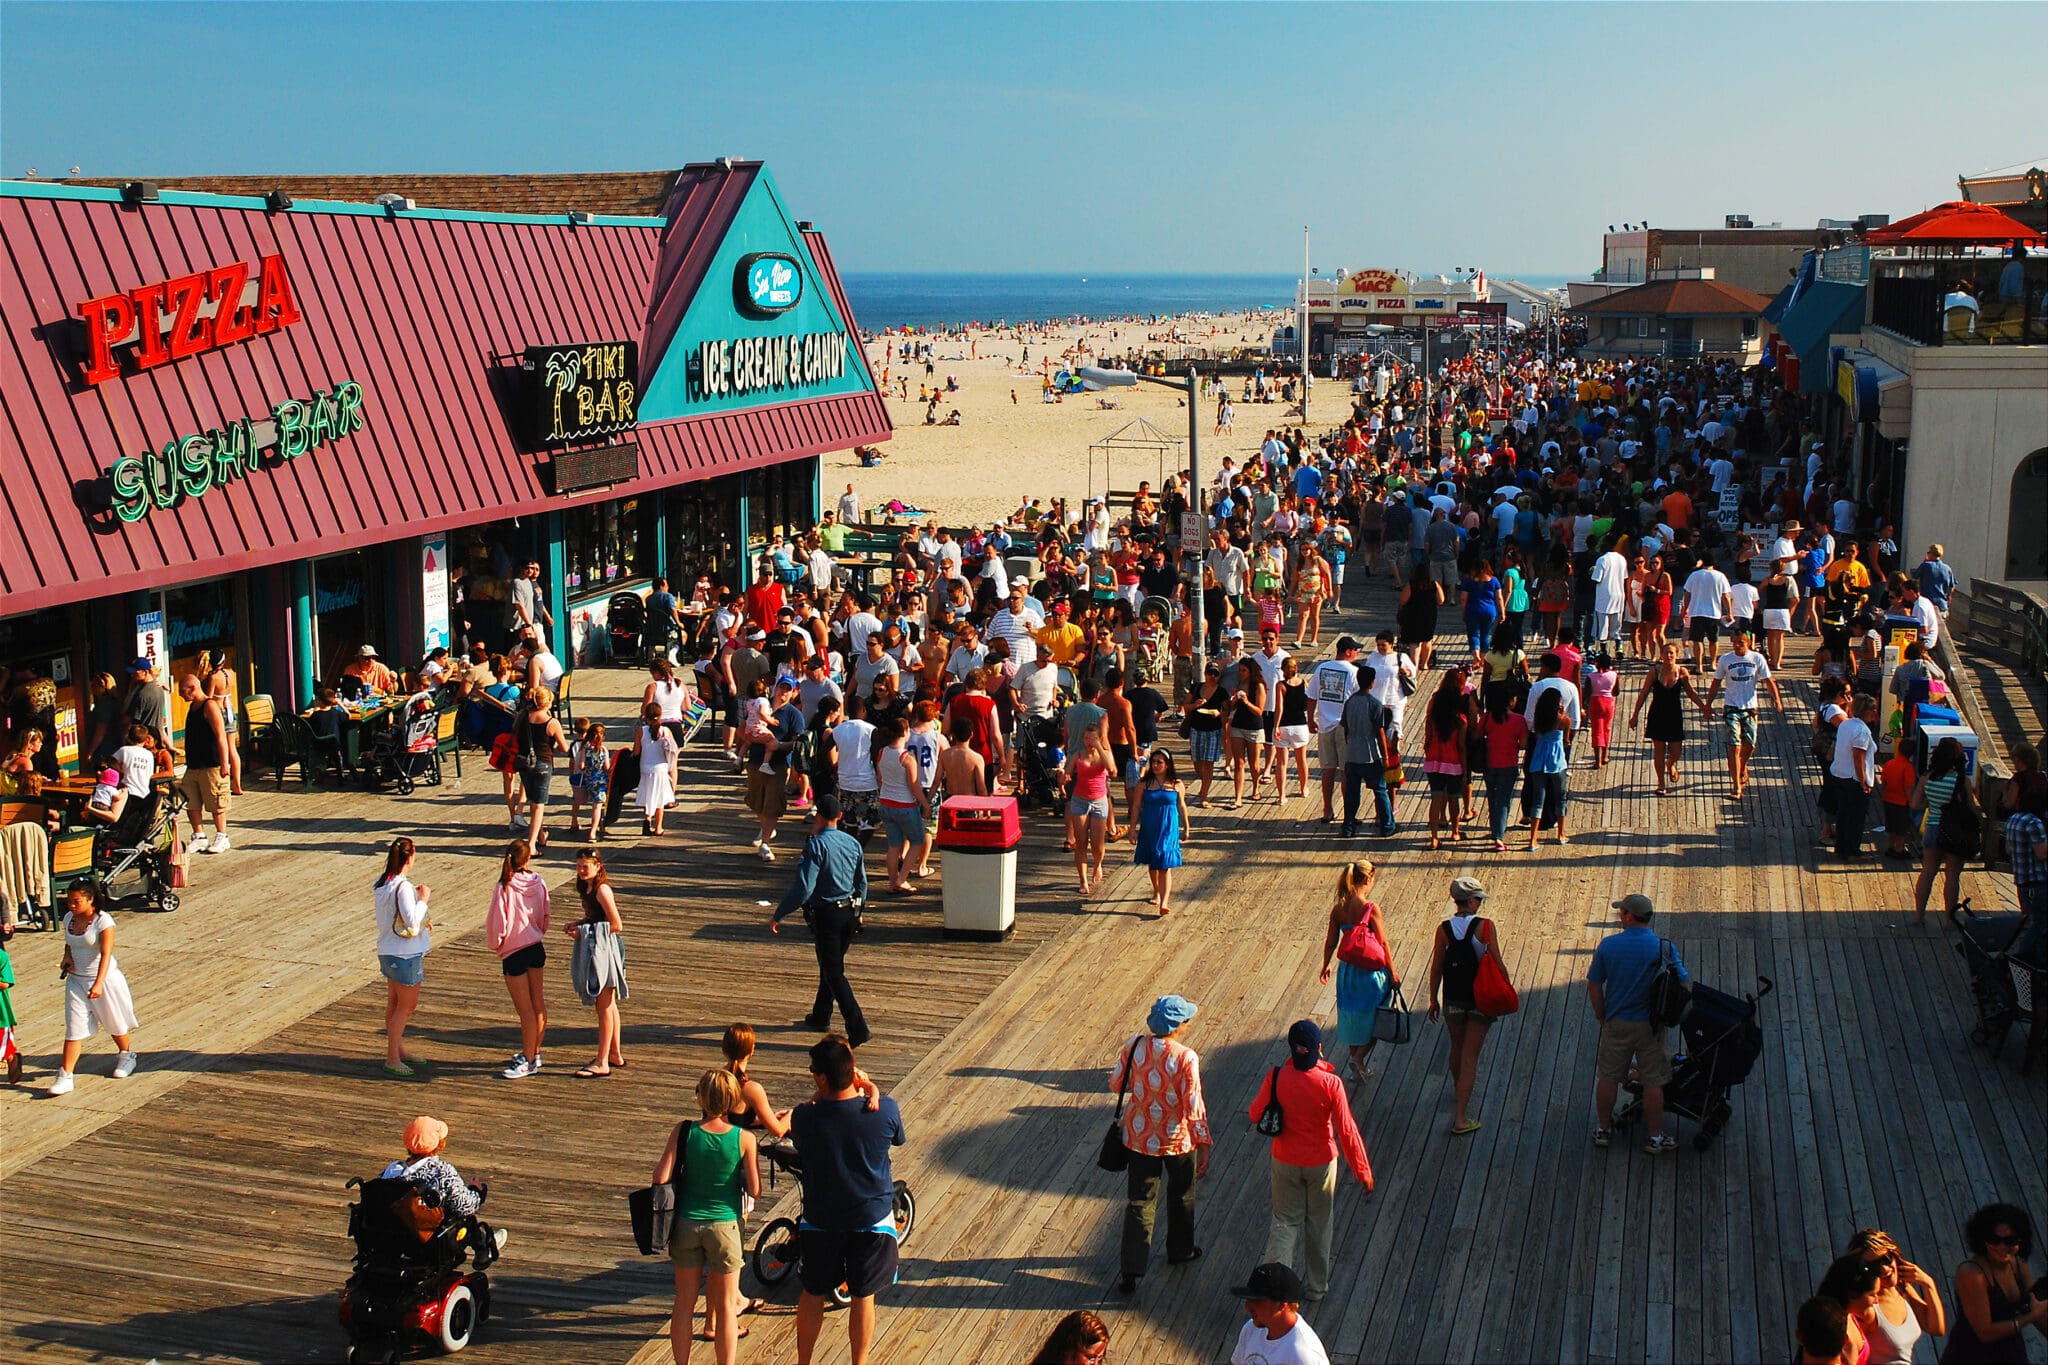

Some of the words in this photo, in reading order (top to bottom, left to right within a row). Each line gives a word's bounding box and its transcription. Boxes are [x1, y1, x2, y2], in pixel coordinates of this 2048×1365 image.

[754, 269, 769, 299] Sea
[771, 260, 792, 290] View
[1351, 270, 1396, 284] LITTLE
[1340, 299, 1368, 308] STEAKS
[1377, 298, 1405, 309] PIZZA
[77, 254, 300, 385] PIZZA
[582, 345, 625, 380] TIKI
[702, 340, 729, 395] ICE
[734, 335, 787, 391] CREAM
[789, 334, 801, 384] &
[804, 331, 848, 381] CANDY
[577, 380, 634, 425] BAR
[111, 416, 258, 522] SUSHI
[273, 380, 363, 460] BAR
[1188, 517, 1195, 525] NO
[1719, 510, 1738, 522] OPE
[1184, 528, 1199, 536] DOGS
[140, 612, 158, 624] HALF
